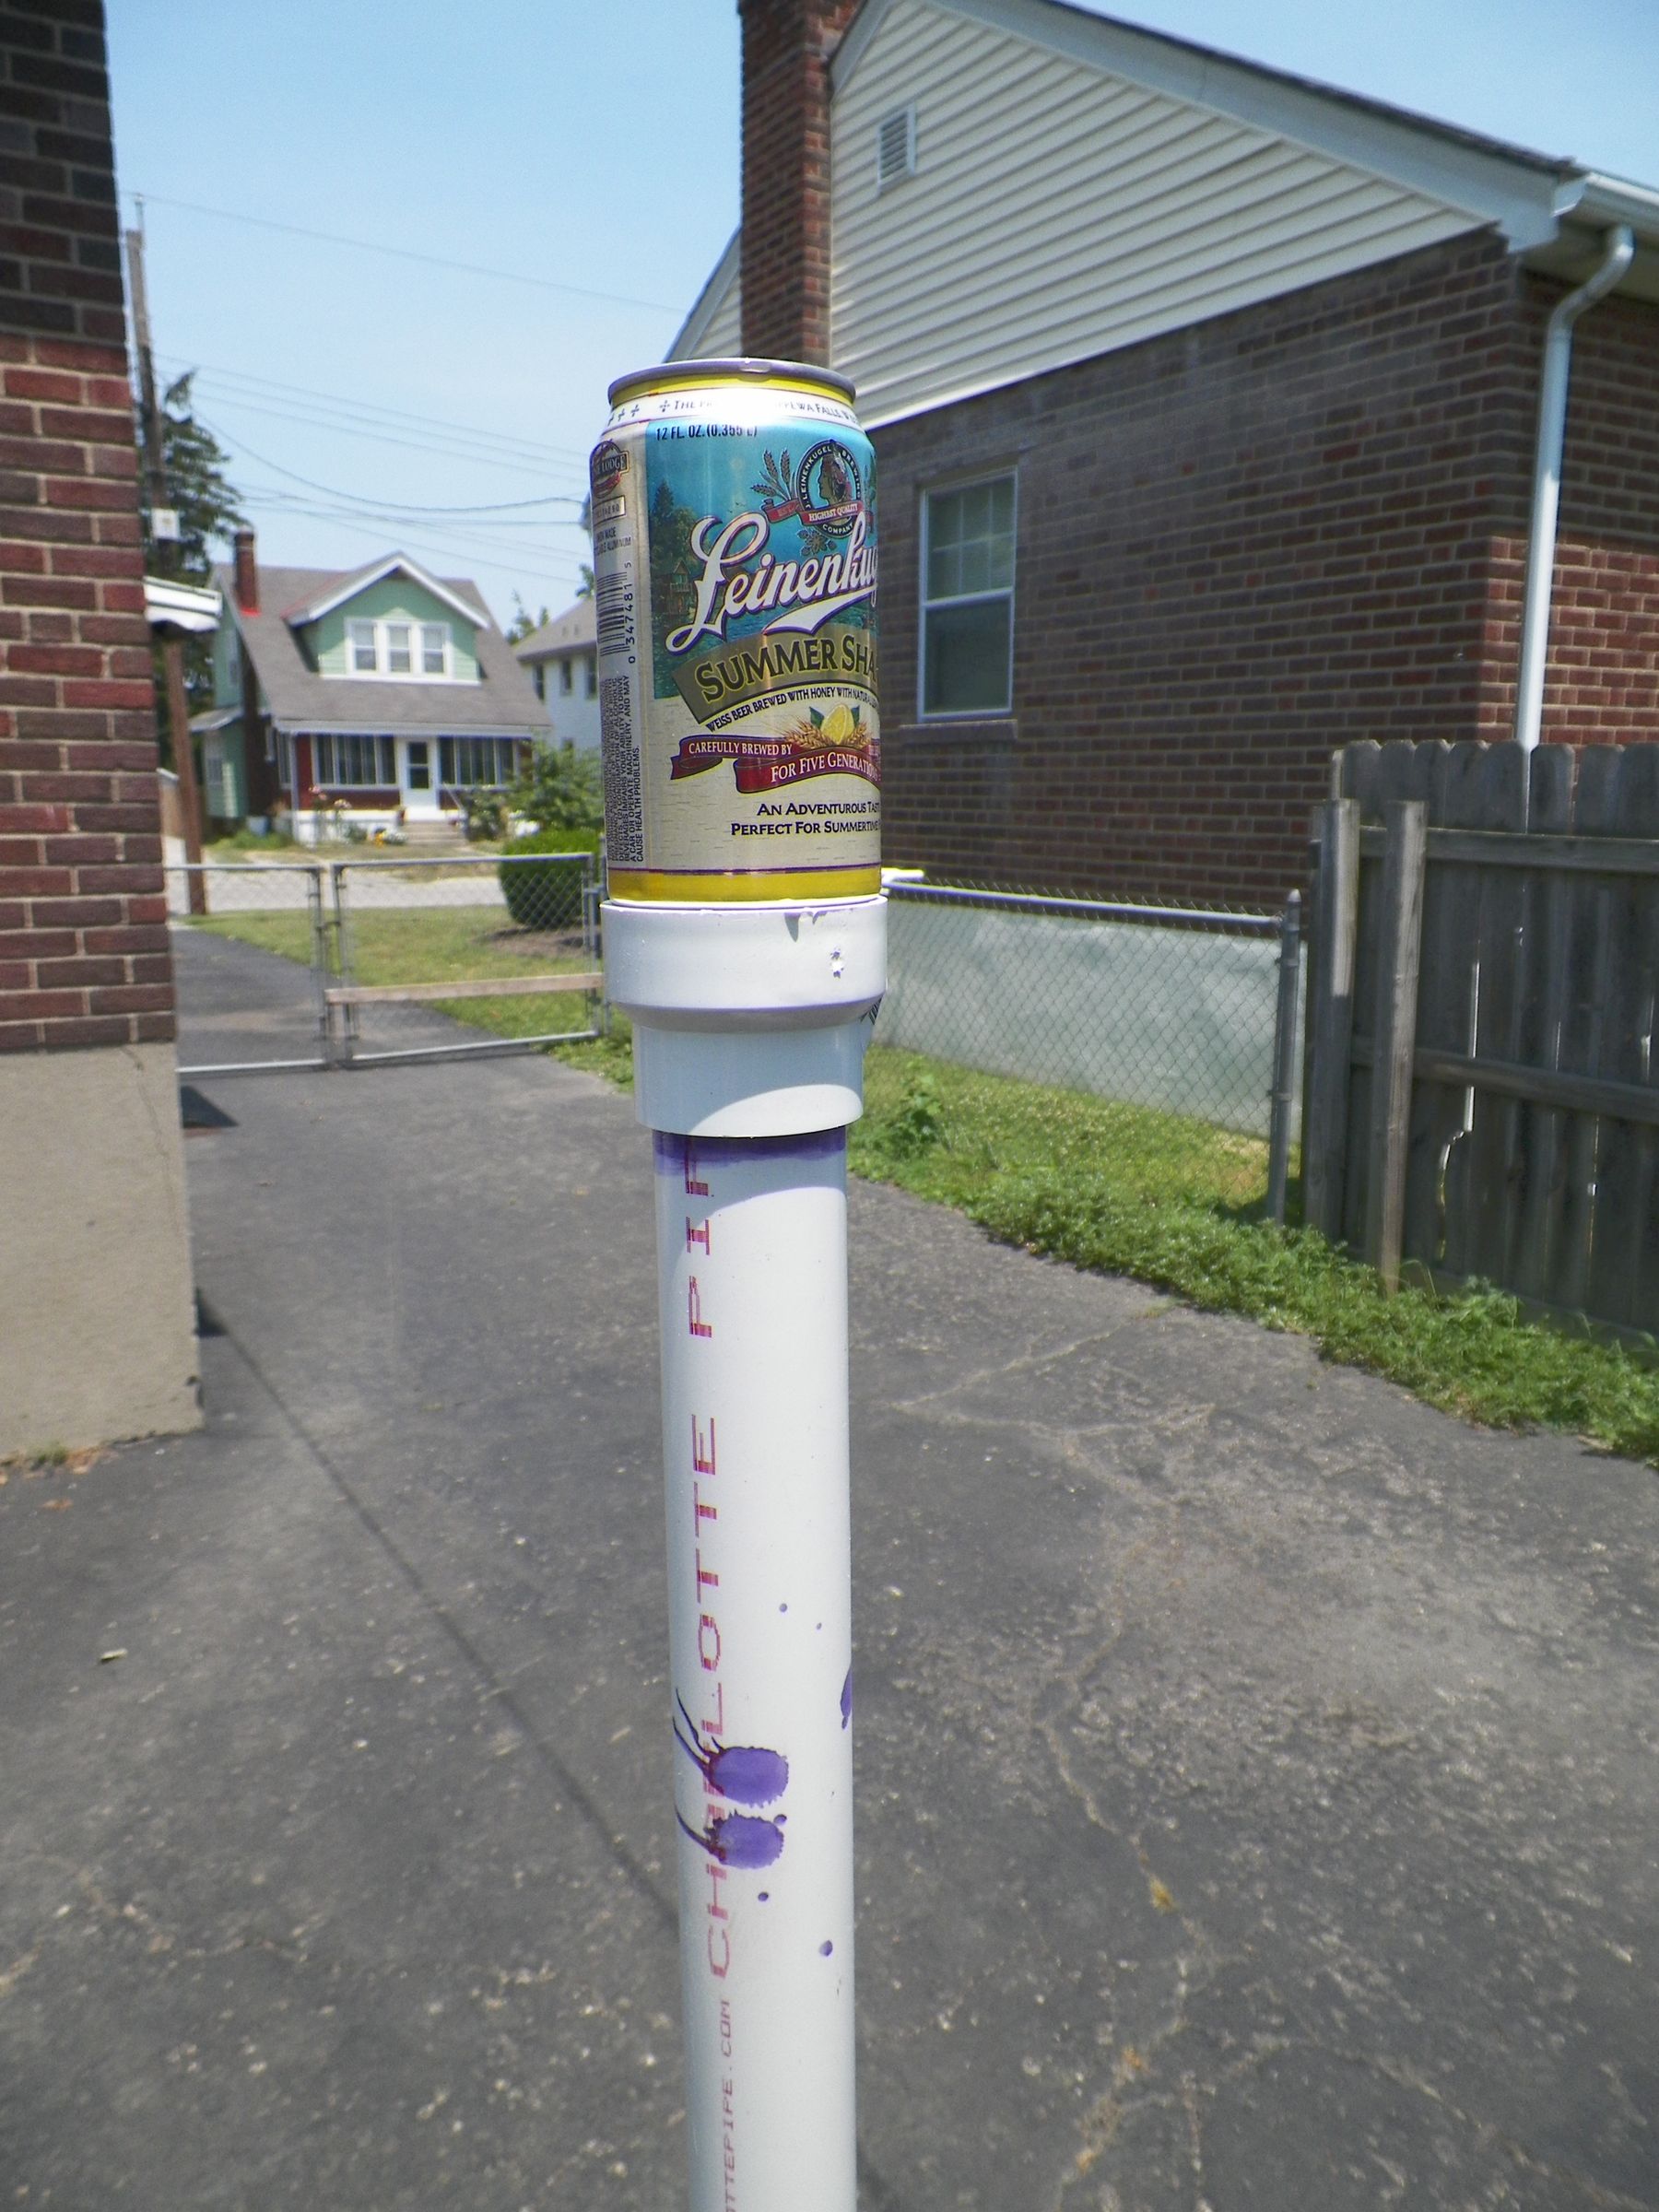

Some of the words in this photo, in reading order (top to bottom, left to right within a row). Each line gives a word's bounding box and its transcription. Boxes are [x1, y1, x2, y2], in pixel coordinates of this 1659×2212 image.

[656, 428, 667, 441] 12
[688, 425, 705, 438] OZ.
[800, 445, 832, 500] LEINENKUGEL
[808, 508, 837, 522] HIGHEST
[837, 503, 858, 515] QUALITY
[822, 522, 853, 535] COMPANY
[696, 638, 839, 703] SUMMER
[705, 713, 732, 733] WEISS
[731, 704, 753, 722] BEER
[752, 692, 787, 713] BREWED
[787, 688, 809, 702] WITH
[810, 686, 836, 699] HONEY
[836, 687, 853, 699] WITH
[624, 719, 633, 775] MACHINERY,
[688, 741, 739, 754] CAREFULLY
[742, 742, 779, 756] BREWED
[781, 744, 793, 756] BY
[632, 745, 641, 795] PROBLEMS.
[771, 762, 796, 782] FOR
[799, 757, 825, 774] FIVE
[634, 797, 642, 831] HEALTH
[757, 803, 782, 816] AN
[785, 802, 866, 816] ADVENTUROUS
[731, 822, 793, 835] PERFECT
[795, 821, 821, 834] FOR
[635, 833, 644, 862] CAUSE
[691, 1414, 730, 1980] CHLOTTE
